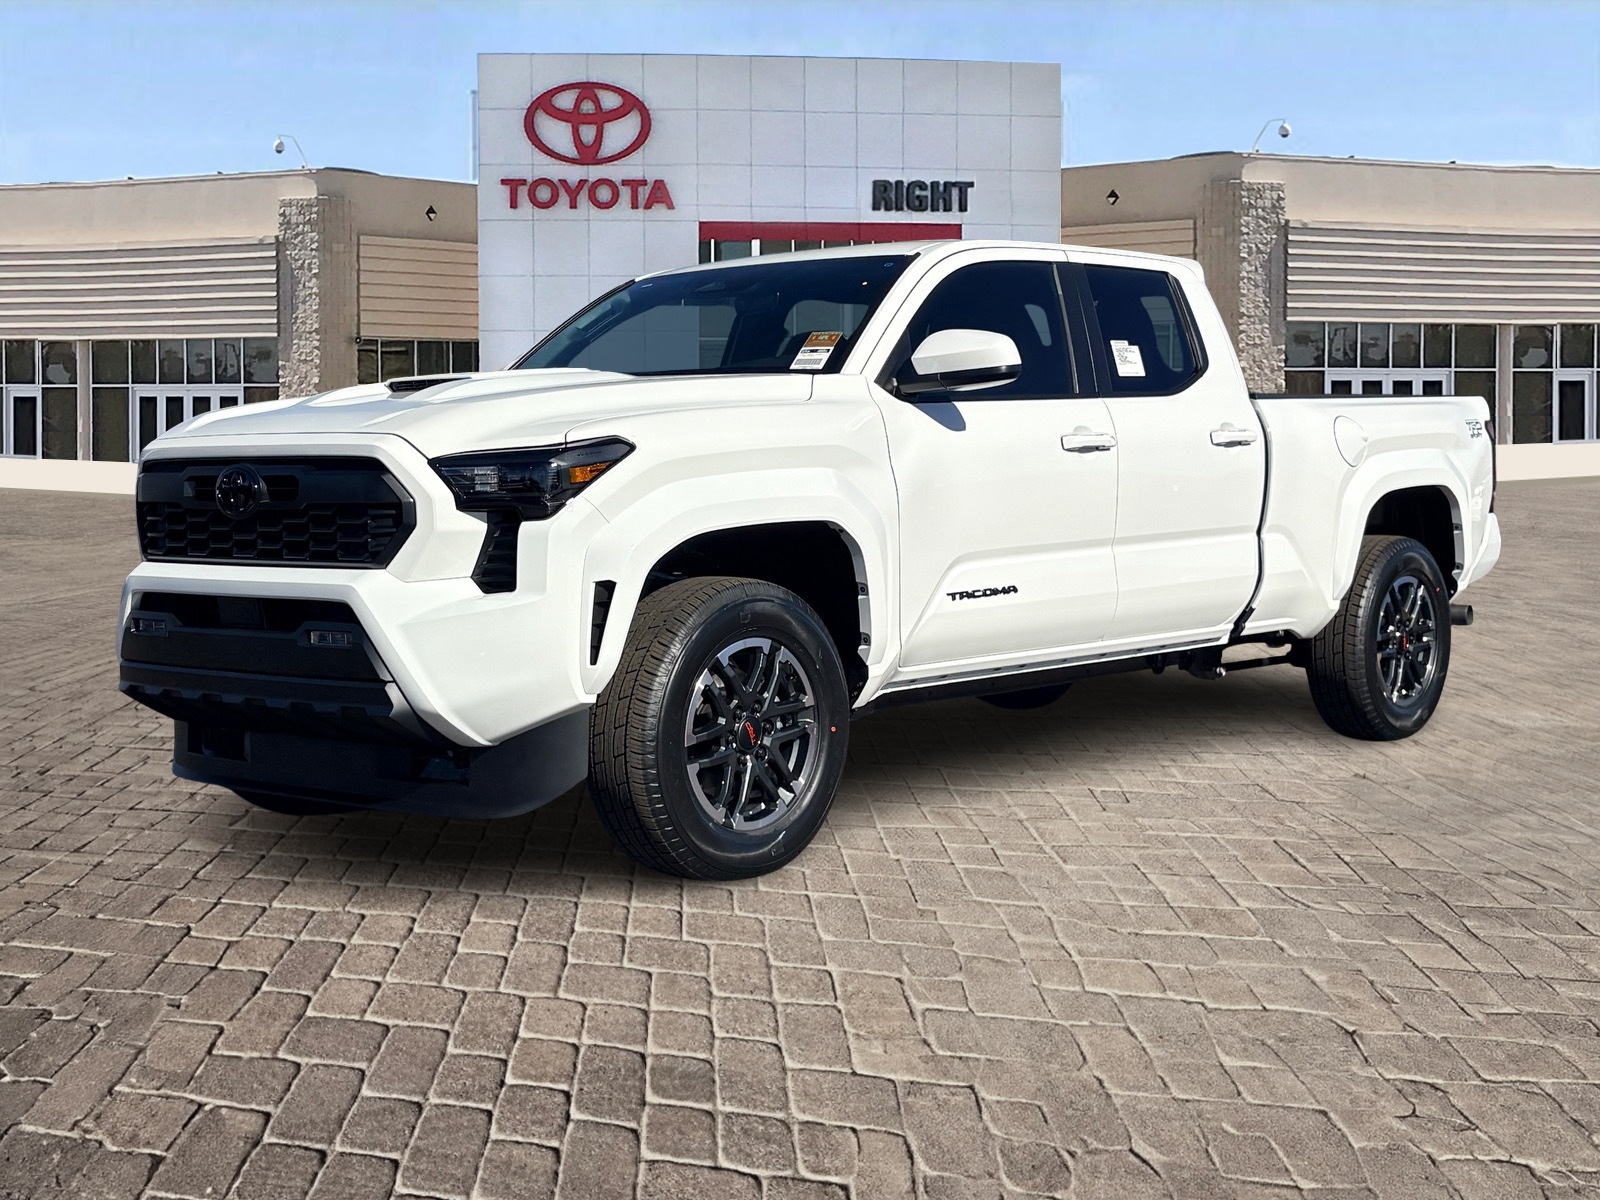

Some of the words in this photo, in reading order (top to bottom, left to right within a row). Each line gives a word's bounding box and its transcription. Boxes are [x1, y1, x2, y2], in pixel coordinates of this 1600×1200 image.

[500, 178, 675, 210] TOYOTA
[872, 179, 975, 212] RIGHT
[946, 585, 1019, 601] TACOMA
